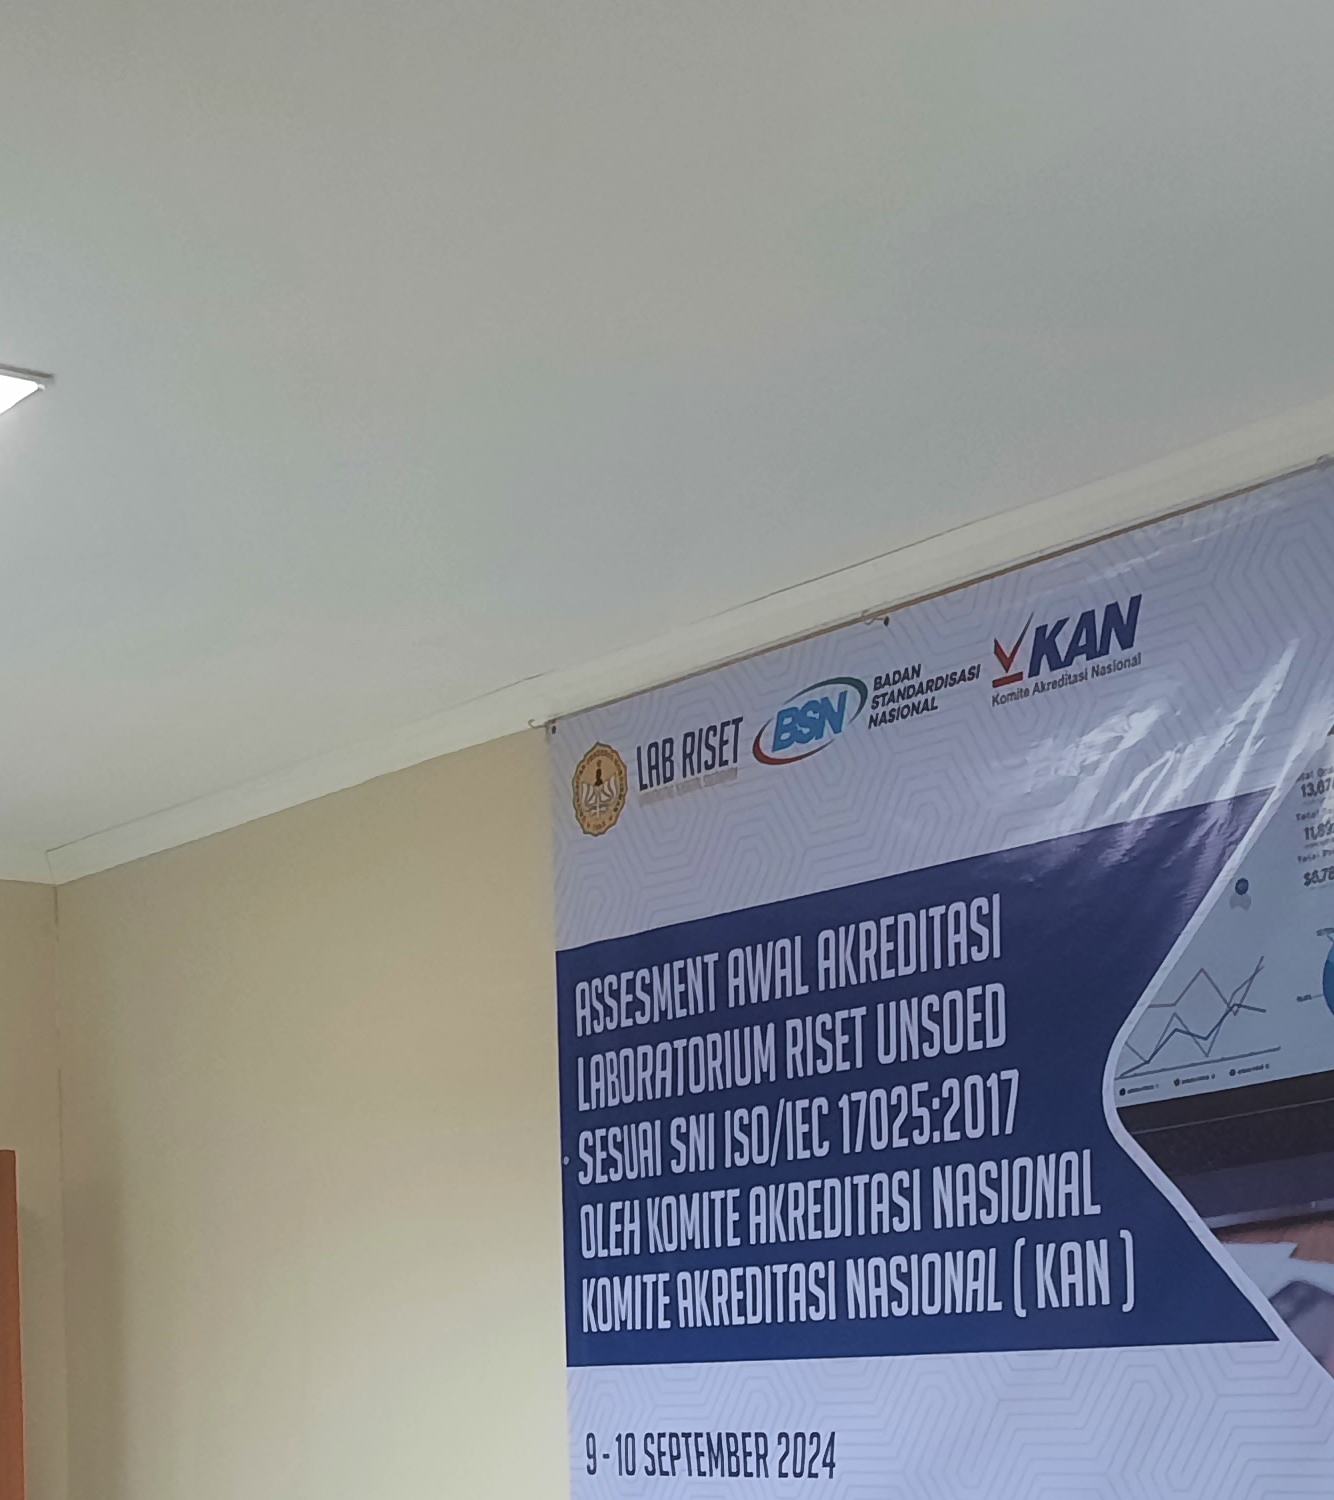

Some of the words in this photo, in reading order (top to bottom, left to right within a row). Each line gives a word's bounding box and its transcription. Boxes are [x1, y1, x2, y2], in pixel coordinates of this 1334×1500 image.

[1028, 594, 1142, 678] KAN
[868, 696, 939, 729] NASIONAL
[870, 664, 981, 710] STANDARDISASI
[873, 663, 922, 691] BADAN
[992, 688, 1030, 707] Komite
[1032, 668, 1088, 696] Akreditasi
[1091, 652, 1142, 679] Nasional
[636, 737, 674, 791] LAB
[682, 716, 744, 778] RISET
[771, 690, 848, 753] BSN
[575, 952, 719, 1037] ASSESMENT
[727, 935, 809, 1008] AWAL
[817, 893, 1001, 991] AKREDITASI
[576, 1022, 776, 1111] LABORATORIUM
[786, 1007, 867, 1079] RISET
[876, 982, 1007, 1065] UNSOED
[578, 1120, 662, 1185] SESUAI
[669, 1112, 716, 1174] SNI
[724, 1096, 829, 1168] ISO/IEC
[838, 1069, 1019, 1154] 17025:2017
[579, 1200, 641, 1259] OLEH
[646, 1188, 741, 1254] KOMITE
[748, 1168, 922, 1245] AKREDITASI
[932, 1148, 1102, 1230] NASIONAL
[581, 1272, 671, 1333] KOMITE
[676, 1260, 836, 1329] AKREDITASI
[845, 1248, 1003, 1322] NASIONAL
[585, 1432, 597, 1475] 9
[615, 1432, 636, 1476] 10
[643, 1431, 769, 1479] SEPTEMBER
[777, 1431, 836, 1479] 2024
